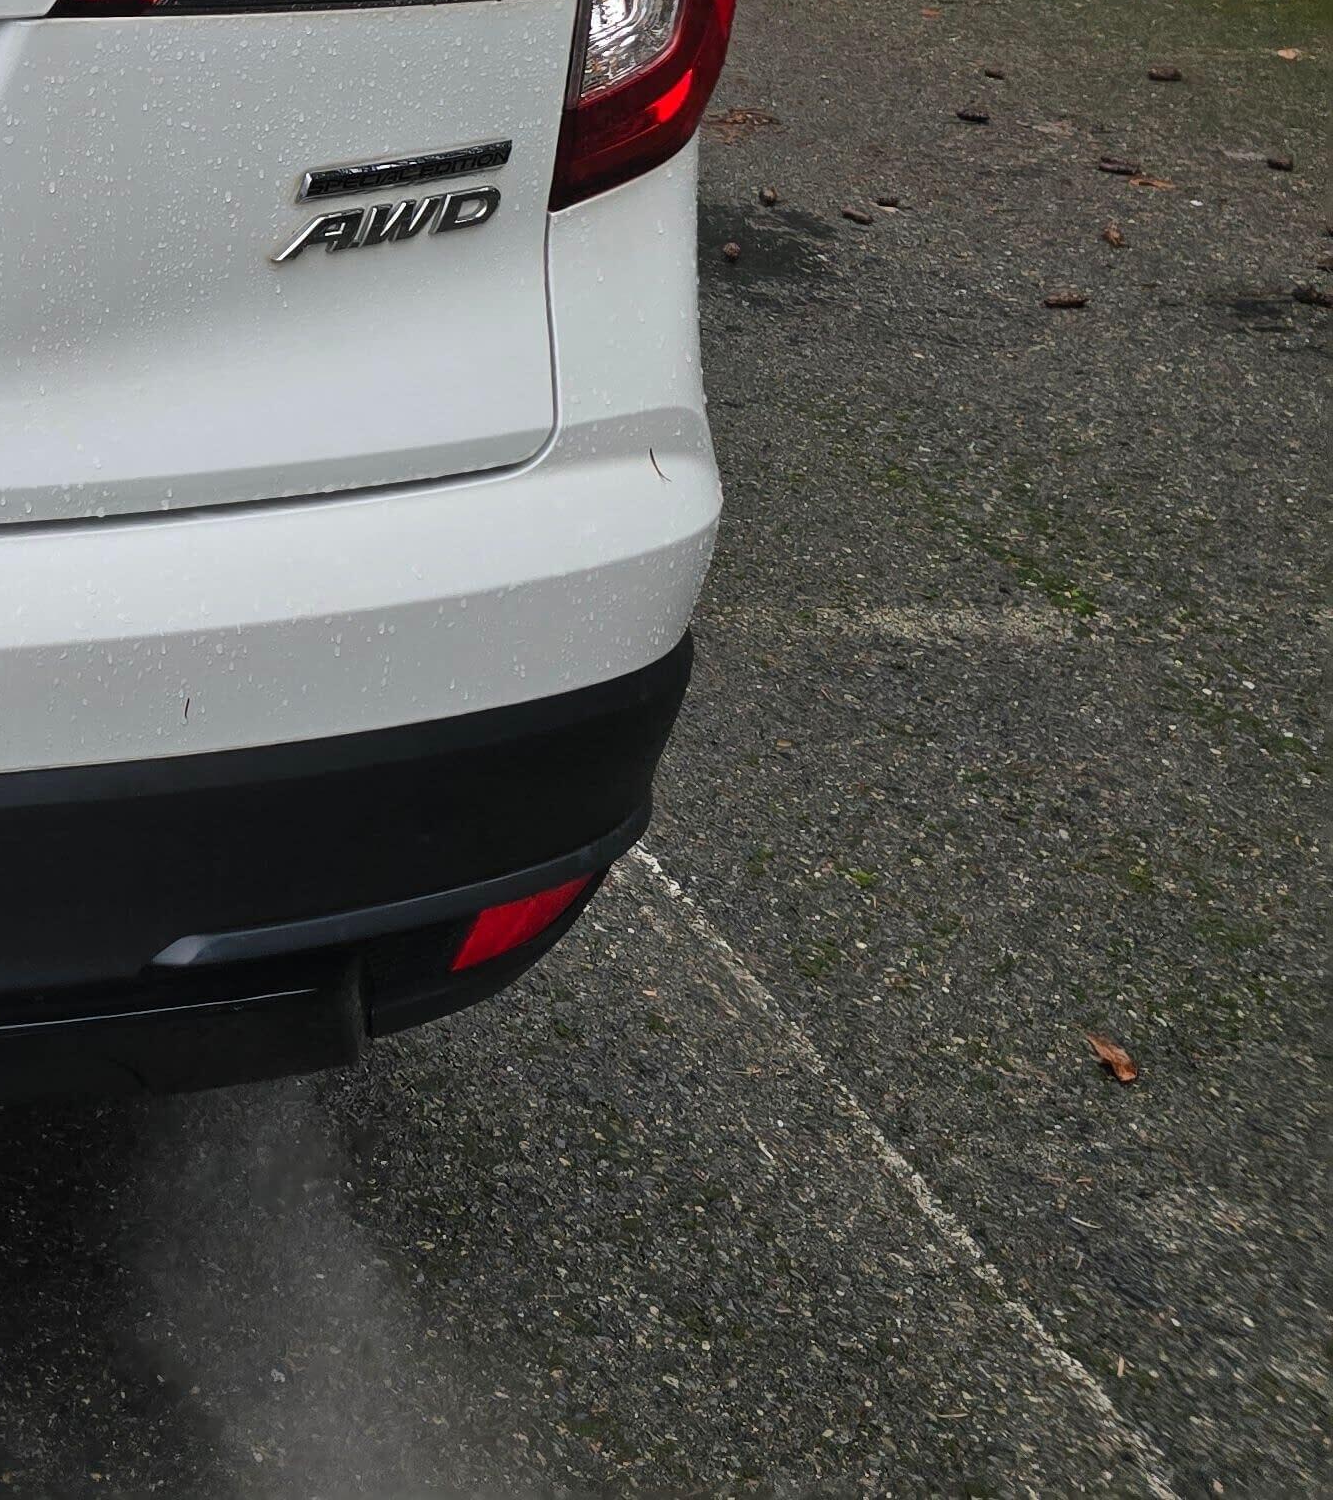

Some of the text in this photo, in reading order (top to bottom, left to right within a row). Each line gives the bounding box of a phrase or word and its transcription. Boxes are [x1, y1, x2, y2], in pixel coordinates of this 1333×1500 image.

[308, 151, 509, 195] SPECIAL EDITION
[269, 185, 501, 262] AWD
